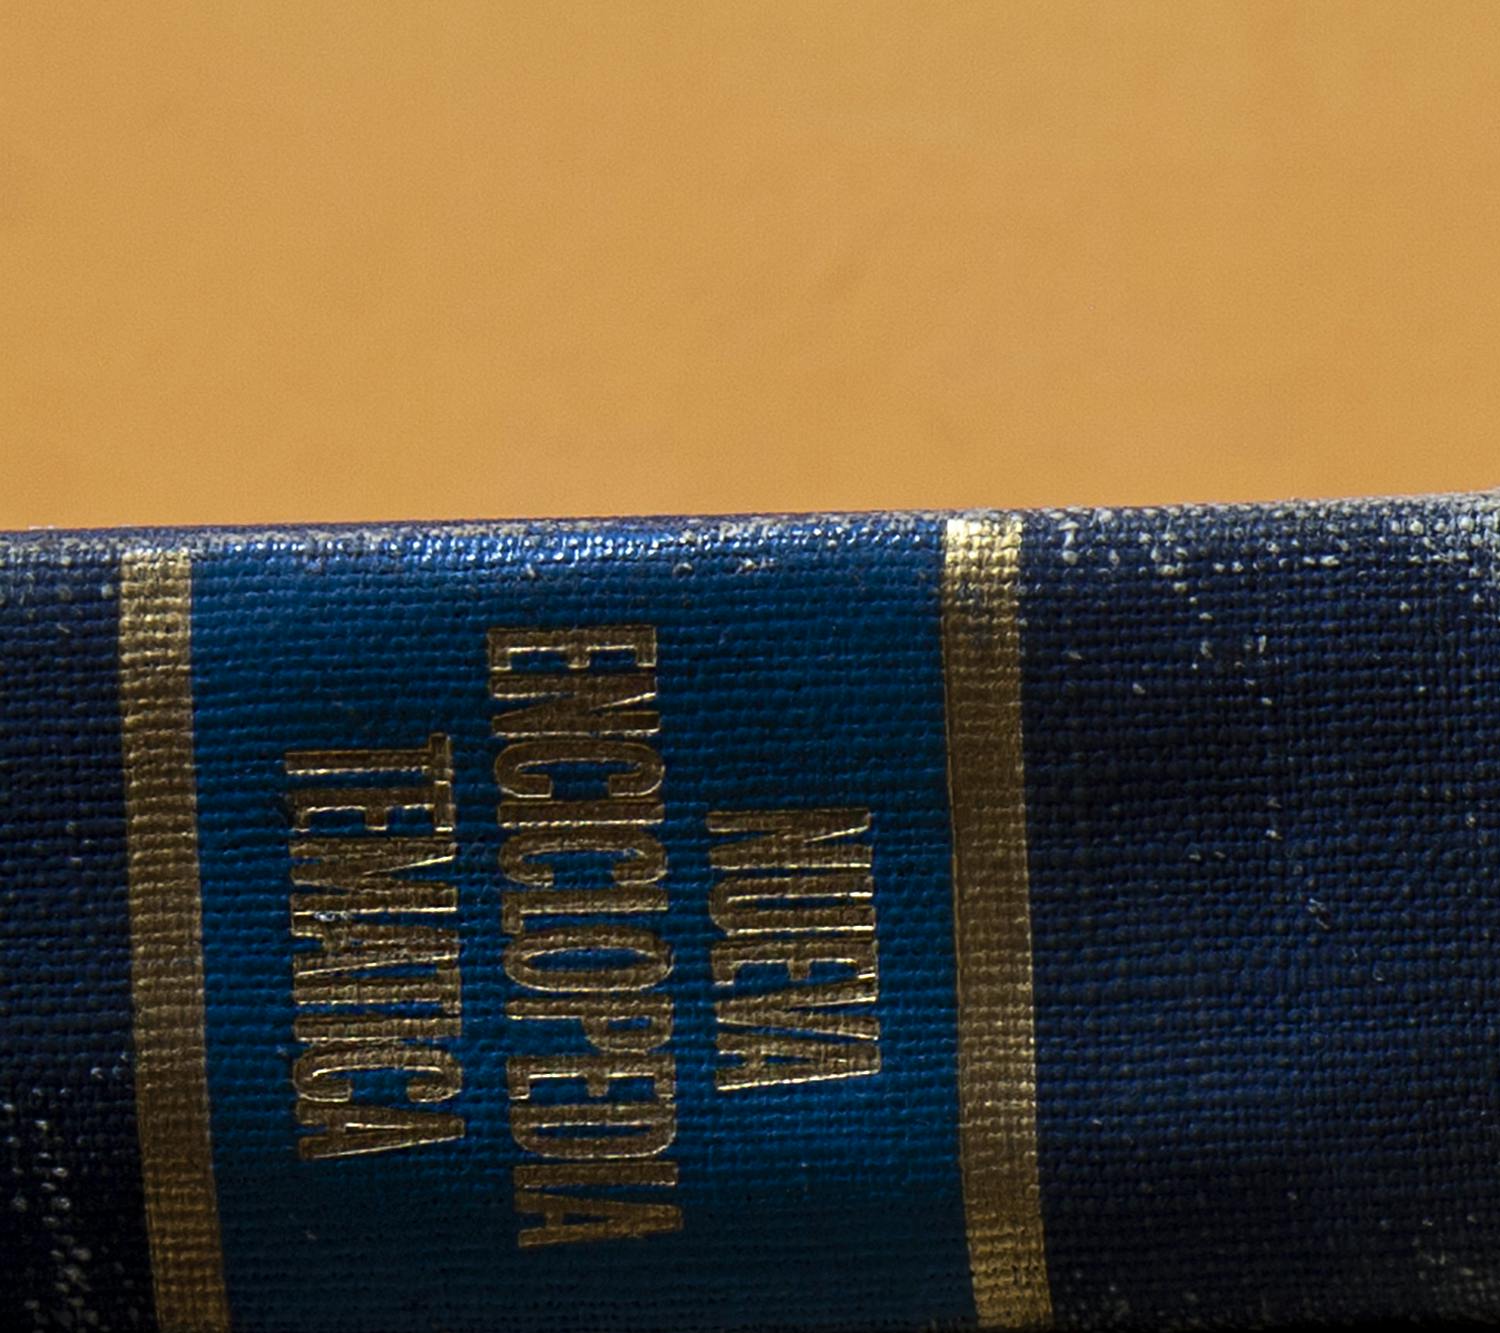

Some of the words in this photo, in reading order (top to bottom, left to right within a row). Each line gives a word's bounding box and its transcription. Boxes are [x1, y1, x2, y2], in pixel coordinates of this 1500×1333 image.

[283, 732, 465, 1161] TEMATICA
[485, 624, 685, 1247] ENCICLOPEDIA
[704, 807, 881, 1093] NUEVA
